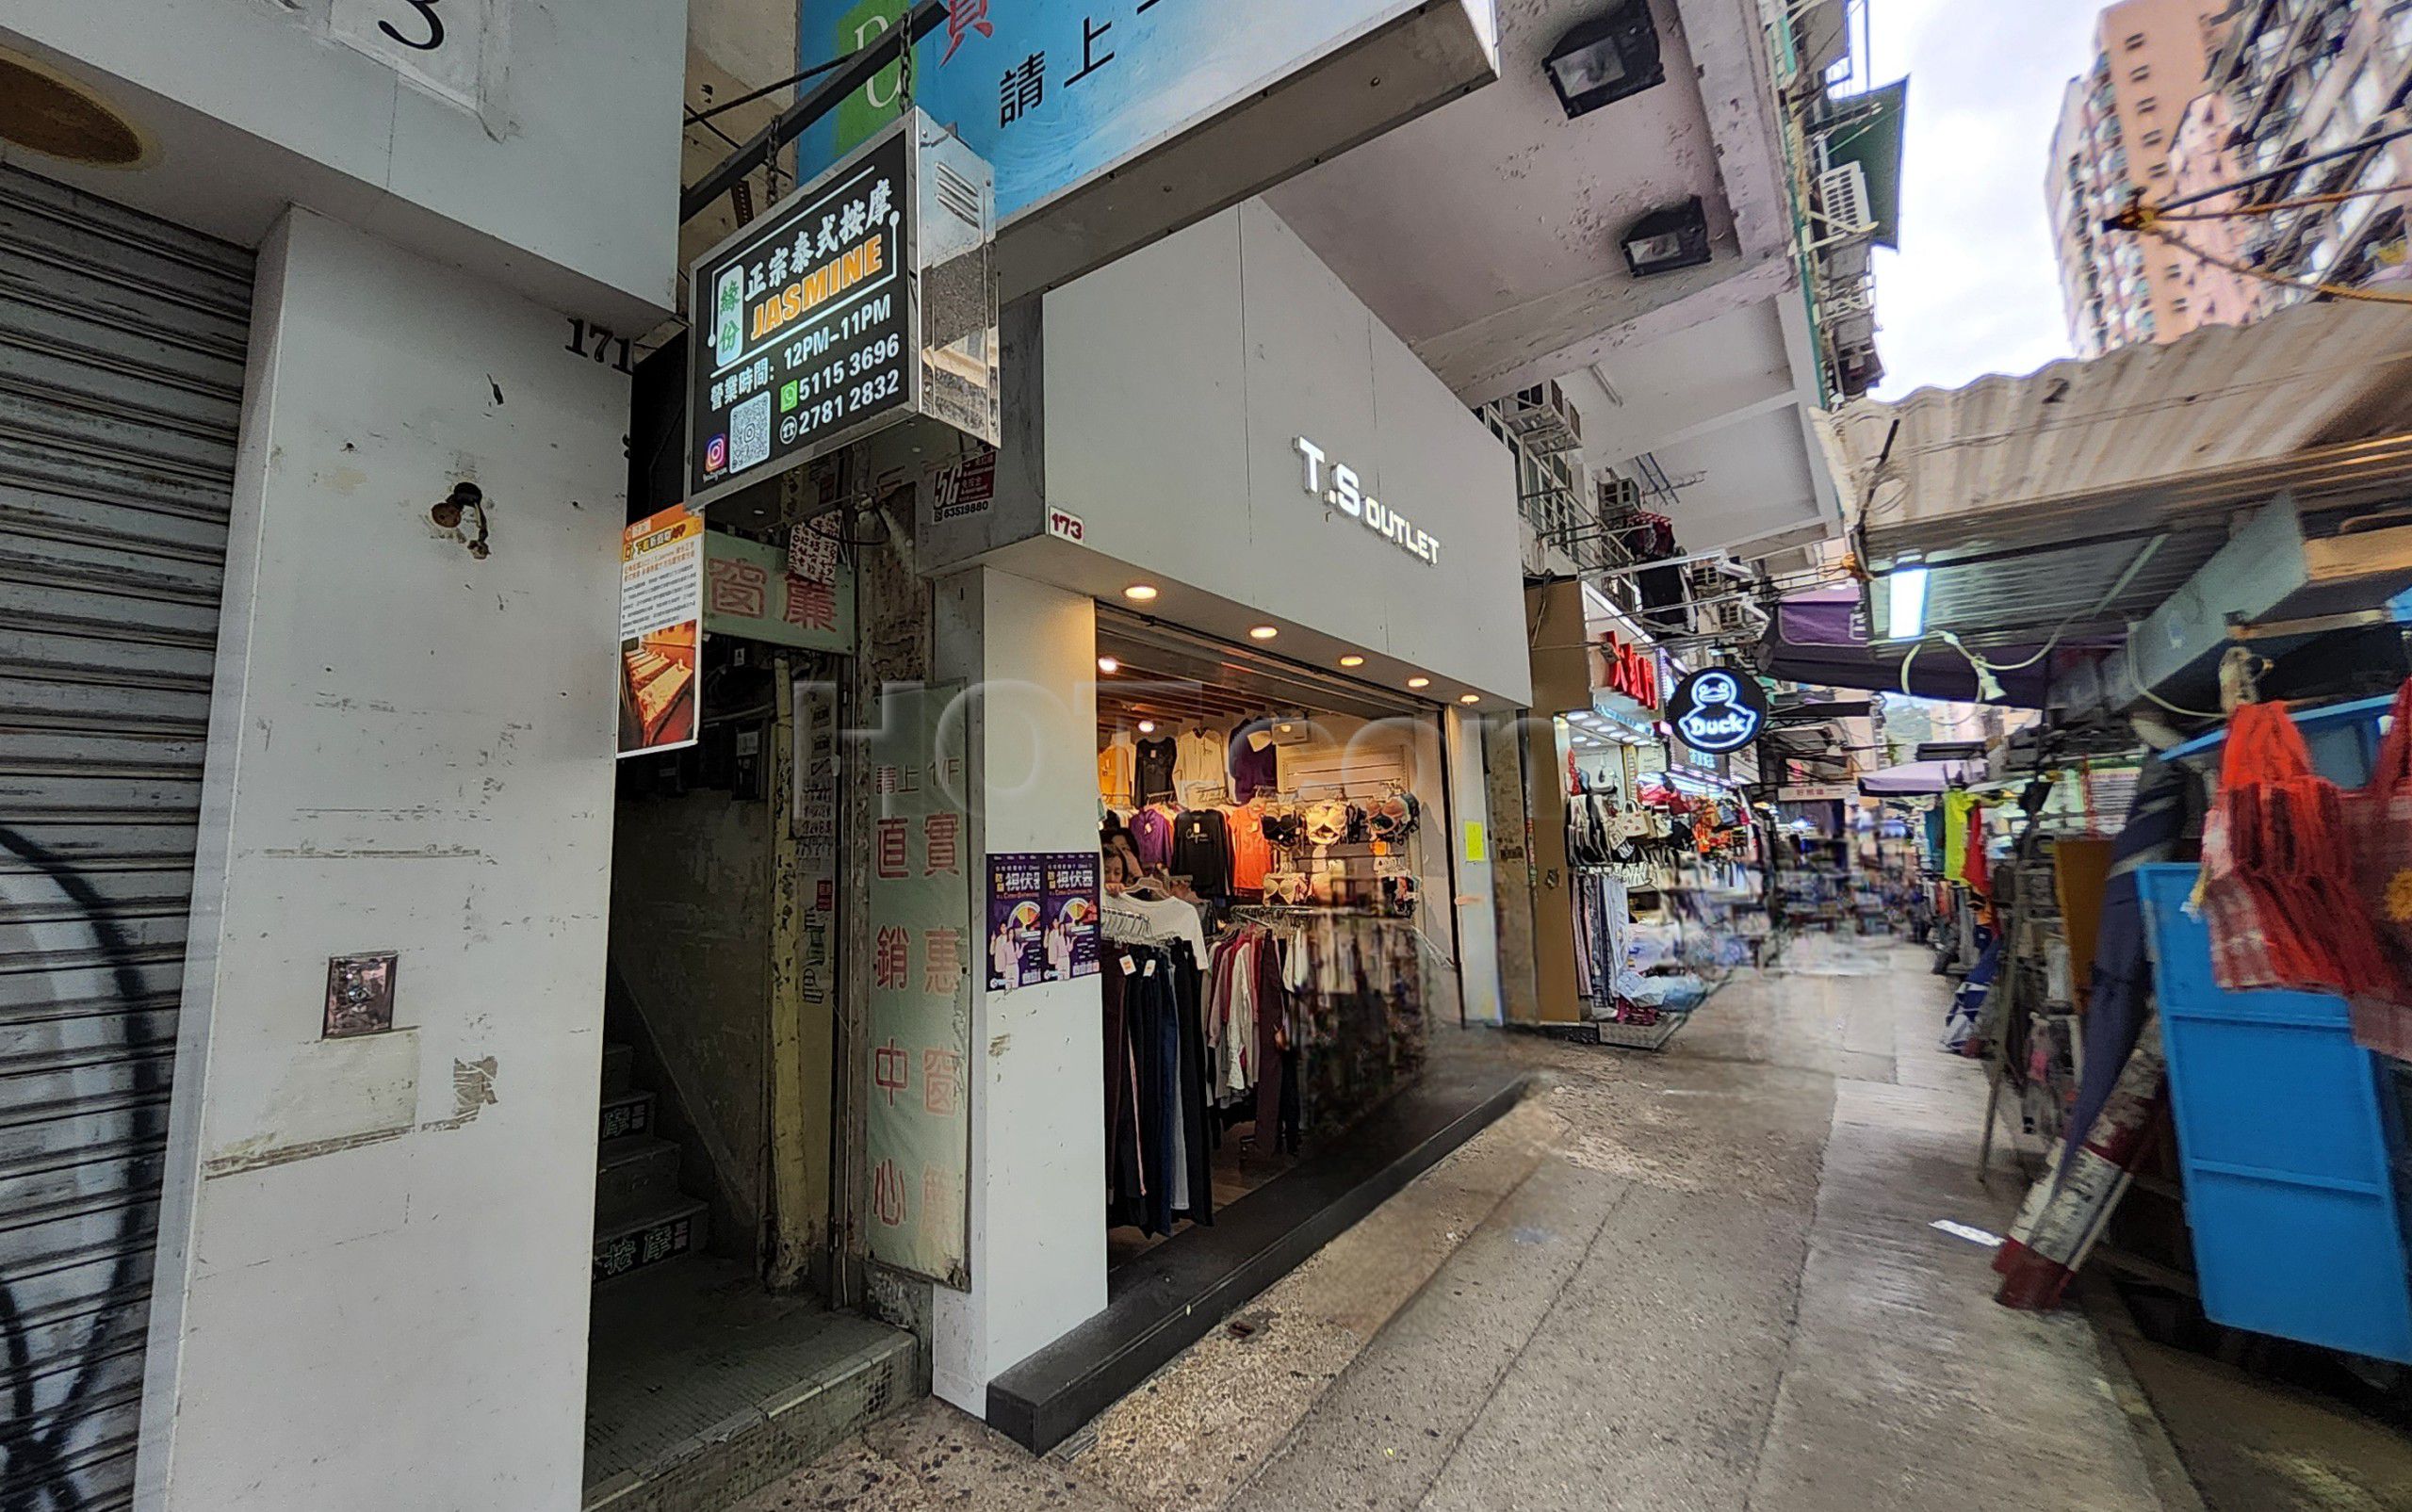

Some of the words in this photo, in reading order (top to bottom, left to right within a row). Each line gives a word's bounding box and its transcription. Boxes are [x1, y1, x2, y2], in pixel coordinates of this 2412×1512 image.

[744, 178, 892, 302] 正宗泰式按摩
[751, 234, 883, 340] JASMINE
[565, 317, 633, 376] 171
[784, 294, 890, 370] 12PM-11PM
[799, 360, 844, 401] 5115
[849, 333, 900, 378] 3696
[799, 395, 843, 435] 2781
[849, 369, 899, 413] 2832
[934, 463, 962, 509] 5G
[1051, 512, 1083, 540] 173
[1362, 496, 1440, 565] OUTLET
[1687, 713, 1747, 736] Duck
[876, 766, 920, 794] 請上
[873, 814, 910, 1226] 直銷中心
